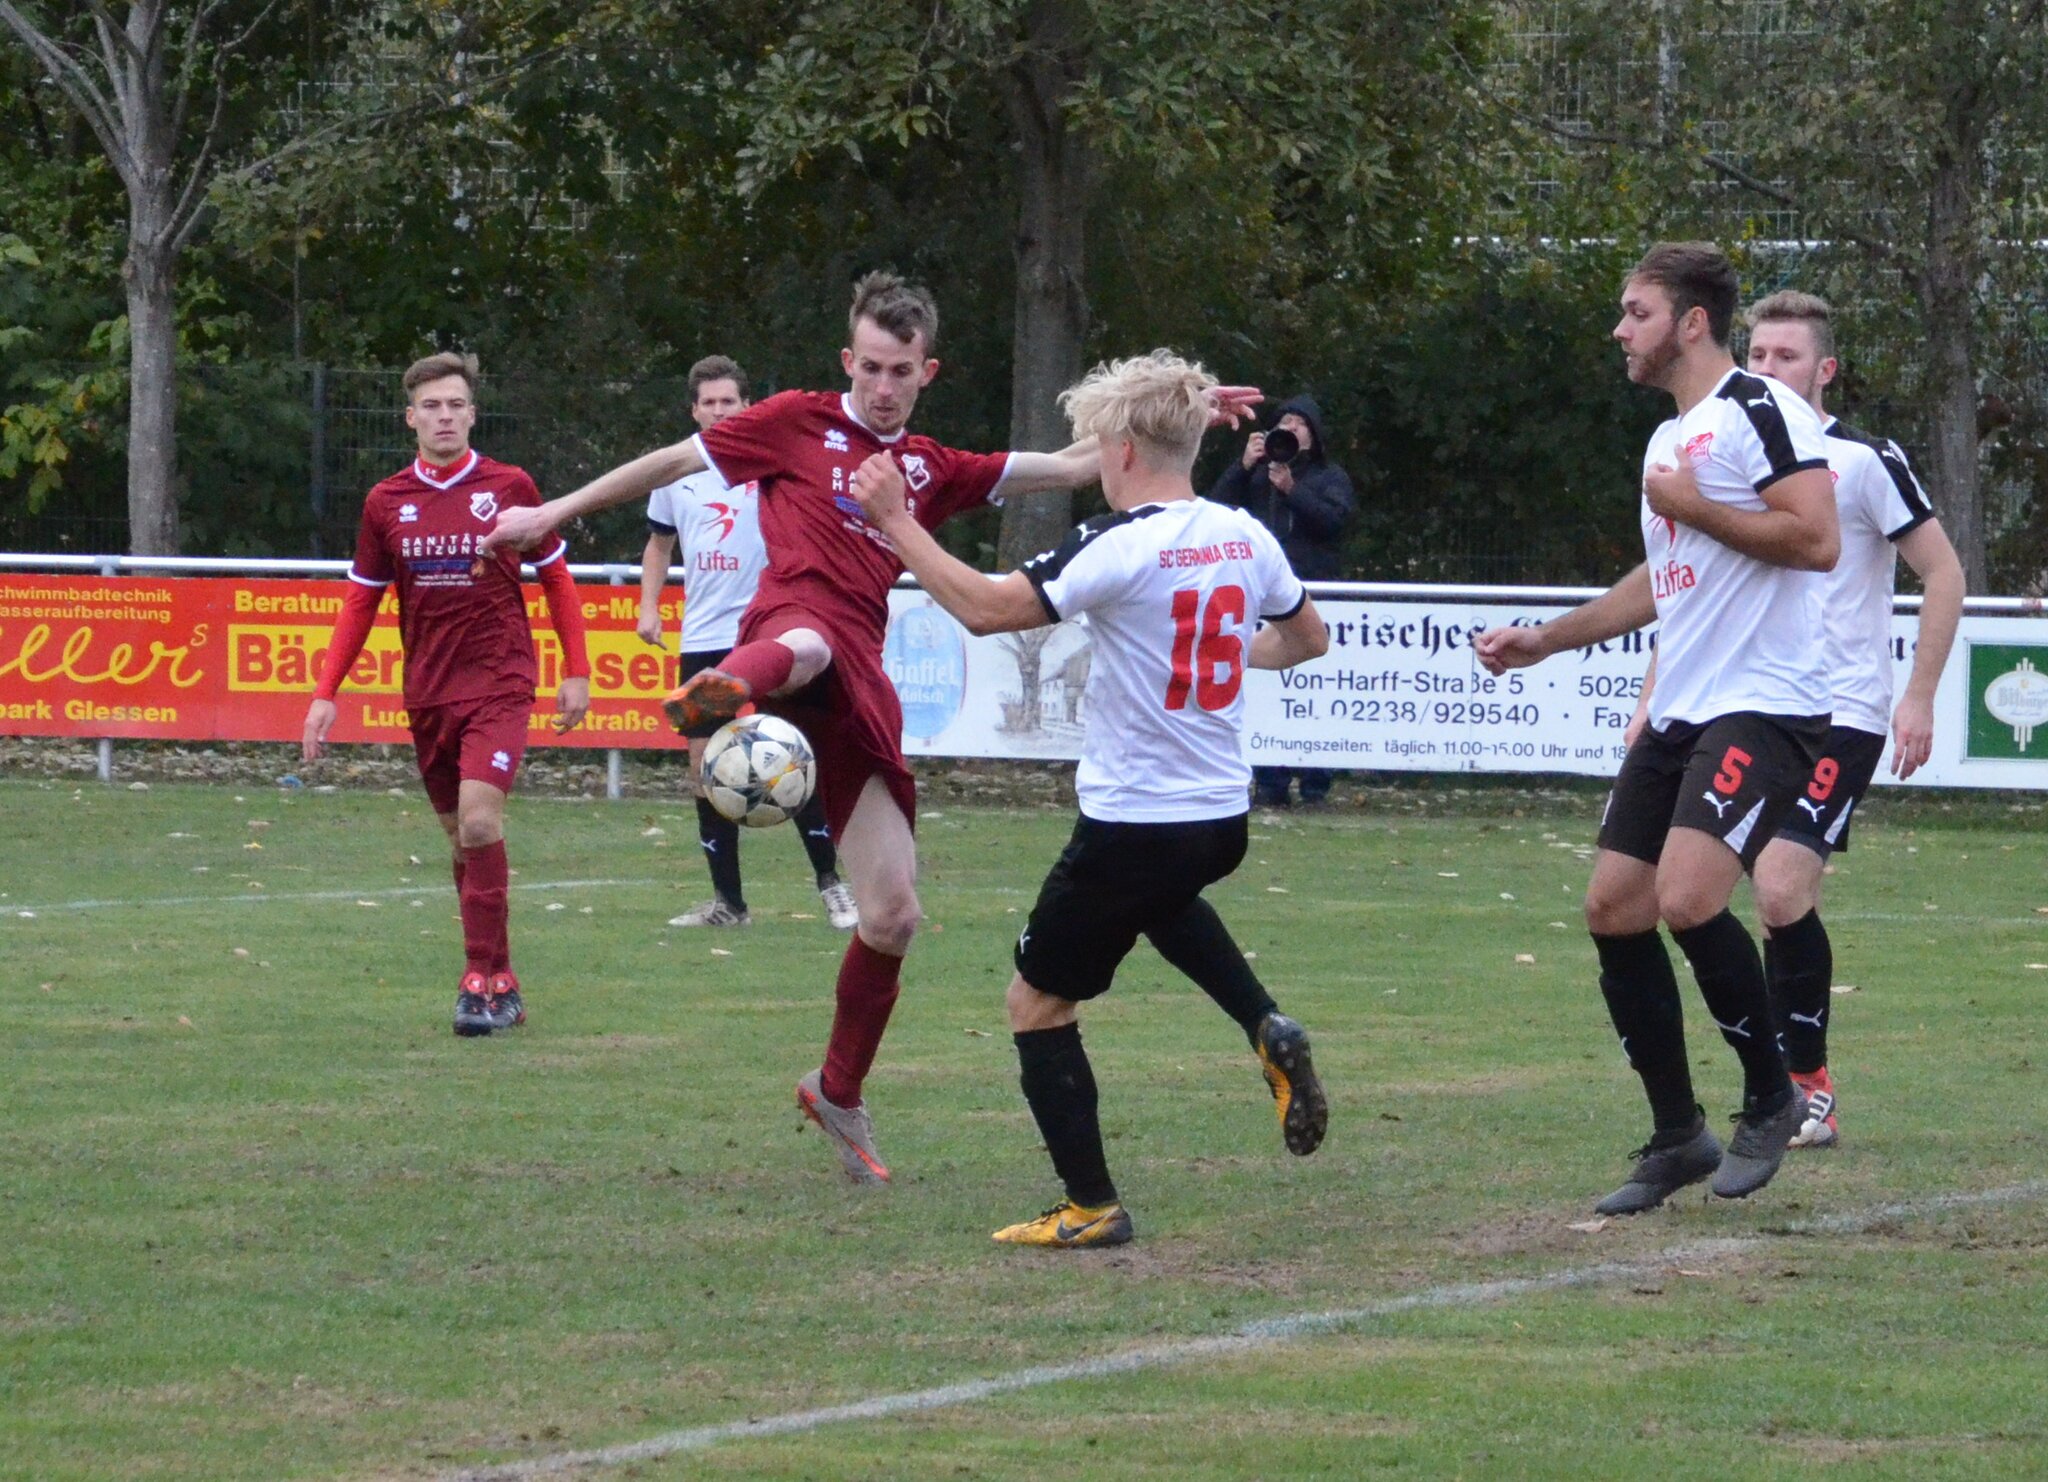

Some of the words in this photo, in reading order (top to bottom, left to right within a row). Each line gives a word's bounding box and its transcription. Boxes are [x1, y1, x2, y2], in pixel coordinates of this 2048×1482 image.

[402, 545, 485, 557] HEIZUNG
[697, 550, 739, 571] Lifta
[1159, 549, 1174, 568] SC
[1655, 560, 1696, 599] Lifta
[234, 590, 344, 614] Beratun
[1164, 584, 1246, 711] 16
[1508, 674, 1524, 695] 5
[1578, 675, 1644, 698] 5025
[1280, 698, 1320, 721] Tel.
[1330, 698, 1540, 726] 02238/929540
[1384, 740, 1436, 757] täglich
[1541, 743, 1568, 758] Uhr
[1574, 746, 1604, 760] und
[1611, 745, 1626, 761] 18
[1712, 745, 1753, 795] 5
[1807, 757, 1840, 800] 9
